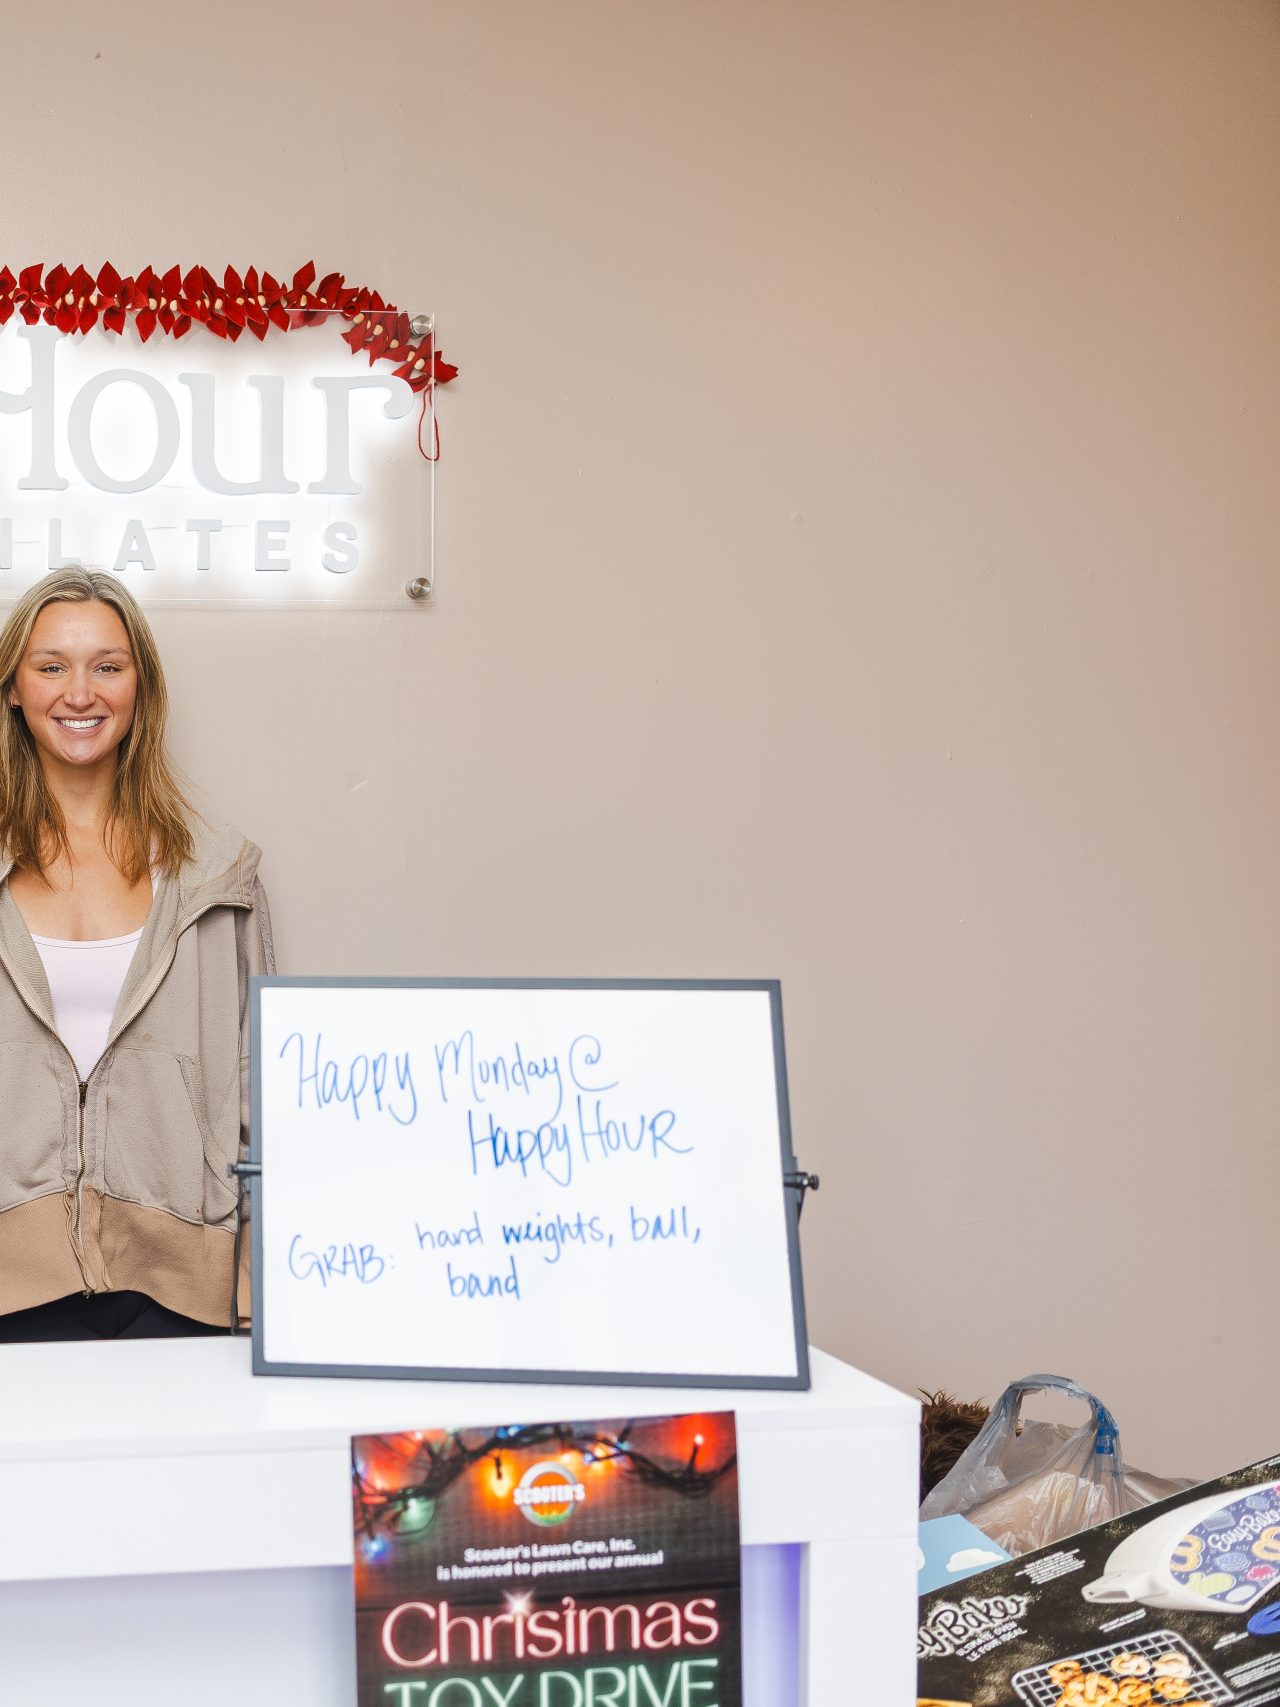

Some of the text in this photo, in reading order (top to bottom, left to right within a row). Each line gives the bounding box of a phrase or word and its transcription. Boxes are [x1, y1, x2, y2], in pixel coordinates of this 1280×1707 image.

[280, 1032, 417, 1125] Happy
[468, 1110, 572, 1187] Happy
[447, 1255, 520, 1300] band
[513, 1483, 586, 1505] SCOOTER'S
[436, 1550, 664, 1581] is honored to present our annual
[464, 1544, 531, 1562] Scooter's
[531, 1543, 571, 1558] Lawn
[609, 1537, 636, 1551] Inc.
[382, 1596, 720, 1667] Christmas
[994, 1620, 1017, 1636] OVEN
[539, 1657, 719, 1707] DRIVE
